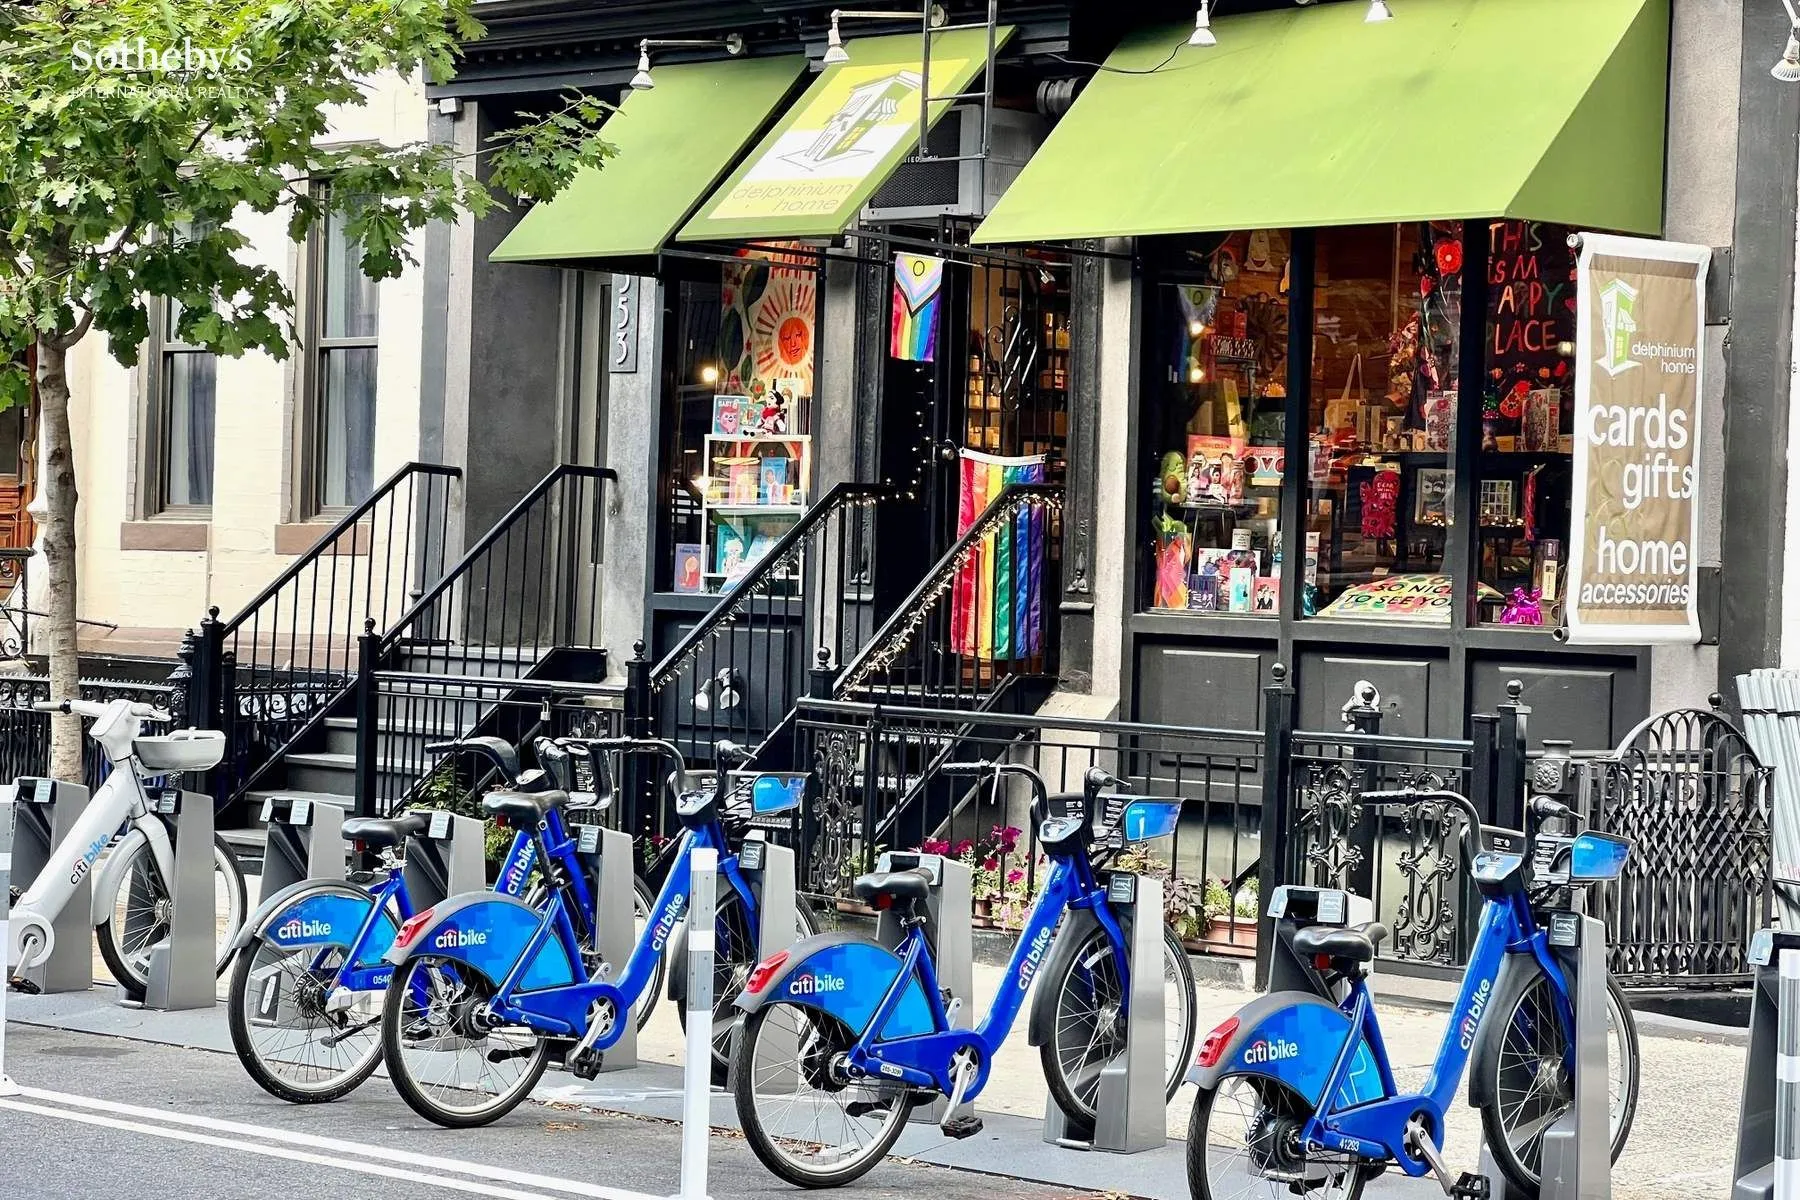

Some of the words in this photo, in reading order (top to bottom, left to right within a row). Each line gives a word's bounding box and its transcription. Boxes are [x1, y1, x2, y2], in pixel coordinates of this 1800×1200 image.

[733, 183, 853, 204] delphinium
[774, 197, 838, 212] home
[1488, 221, 1542, 253] THIS
[1497, 281, 1564, 316] APPY
[1632, 341, 1695, 359] delphinium
[1661, 360, 1695, 374] home
[1588, 393, 1688, 449] cards
[1623, 452, 1693, 510] gifts
[1597, 526, 1687, 575] home
[1345, 594, 1372, 603] TO
[1376, 595, 1415, 605] SEE
[1419, 596, 1452, 607] YO
[1374, 583, 1405, 592] SO
[1581, 578, 1689, 604] accessories
[71, 860, 88, 885] citi
[83, 834, 108, 864] bike
[514, 838, 535, 871] bike
[506, 868, 525, 896] citi
[660, 893, 684, 927] bike
[278, 921, 301, 940] citi
[302, 919, 331, 938] bike
[435, 931, 457, 949] citi
[459, 929, 487, 947] bike
[652, 925, 669, 951] citi
[1018, 960, 1036, 990] citi
[1027, 927, 1051, 963] bike
[789, 976, 813, 995] citi
[814, 974, 845, 993] bike
[1468, 978, 1490, 1020] bike
[1460, 1018, 1477, 1050] citi
[1244, 1043, 1267, 1064] citi
[1268, 1038, 1298, 1061] bike
